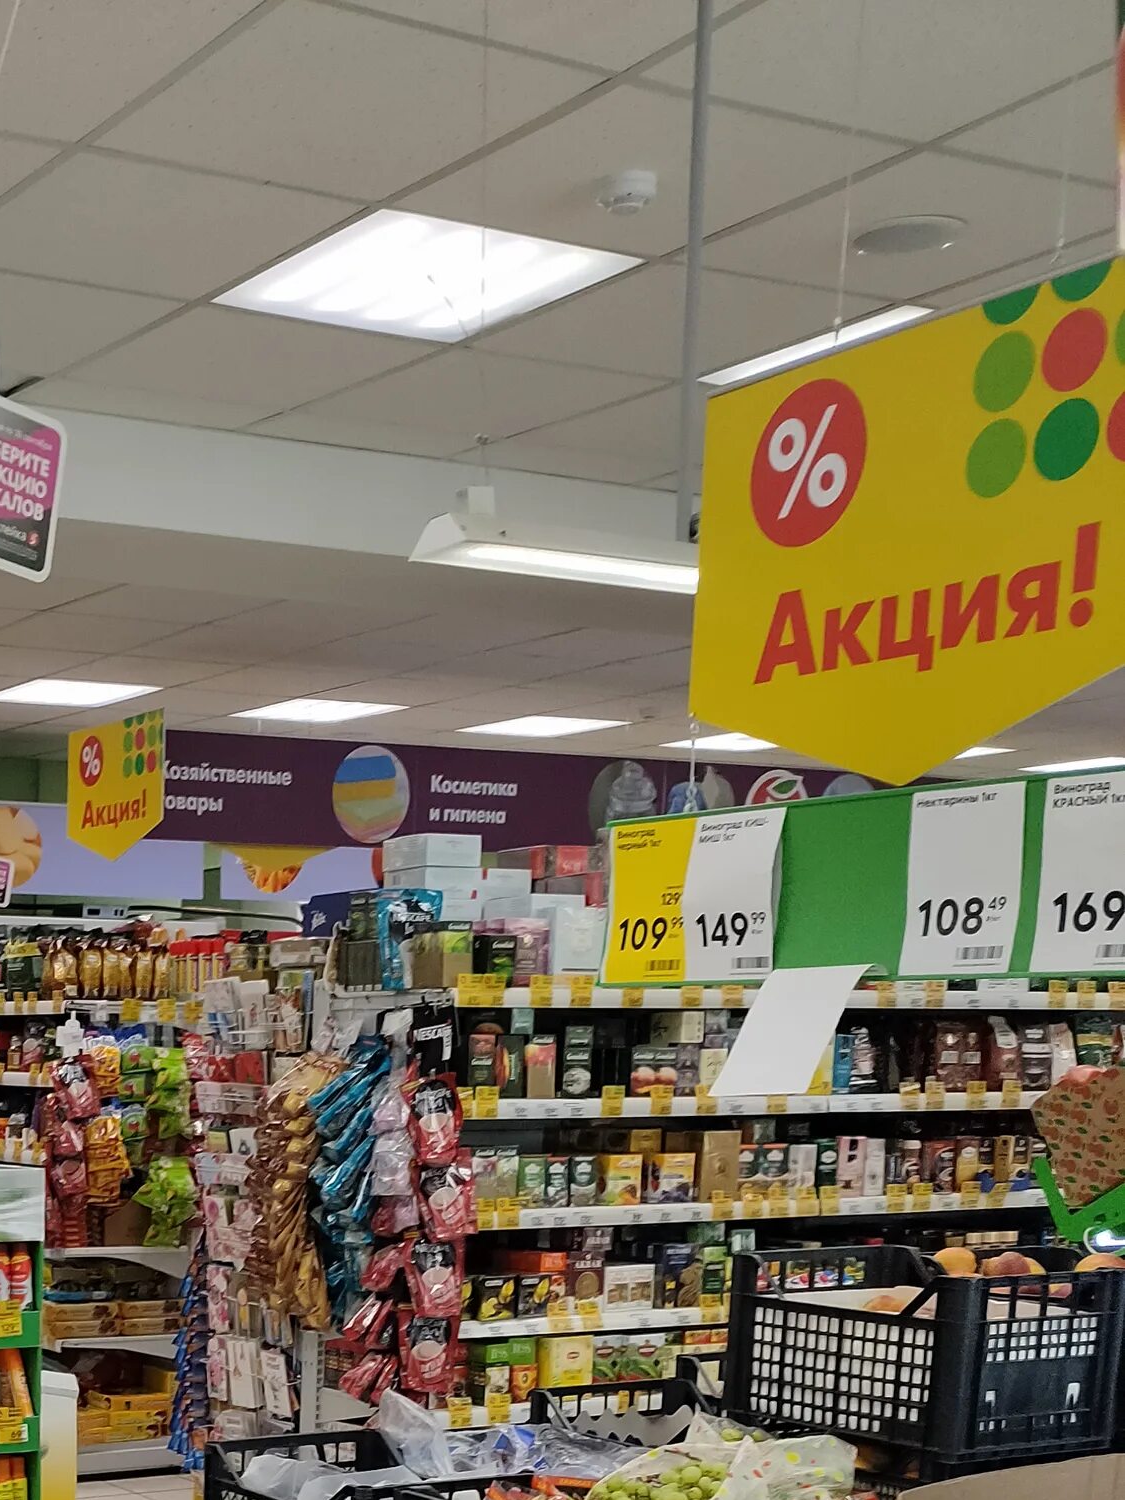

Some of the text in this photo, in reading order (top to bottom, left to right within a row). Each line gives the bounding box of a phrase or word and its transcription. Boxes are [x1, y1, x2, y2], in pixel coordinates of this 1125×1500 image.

[754, 522, 1102, 685] Акция!
[430, 773, 518, 798] Косметика
[1052, 793, 1109, 809] КРАСНЫЙ
[1054, 782, 1111, 795] Виноград
[81, 788, 148, 830] Акция!
[164, 795, 223, 816] овары
[429, 808, 506, 825] и гигиена
[918, 896, 1007, 937] 108 49
[1052, 890, 1125, 933] 169
[619, 916, 667, 951] 109
[695, 911, 766, 948] 149 99
